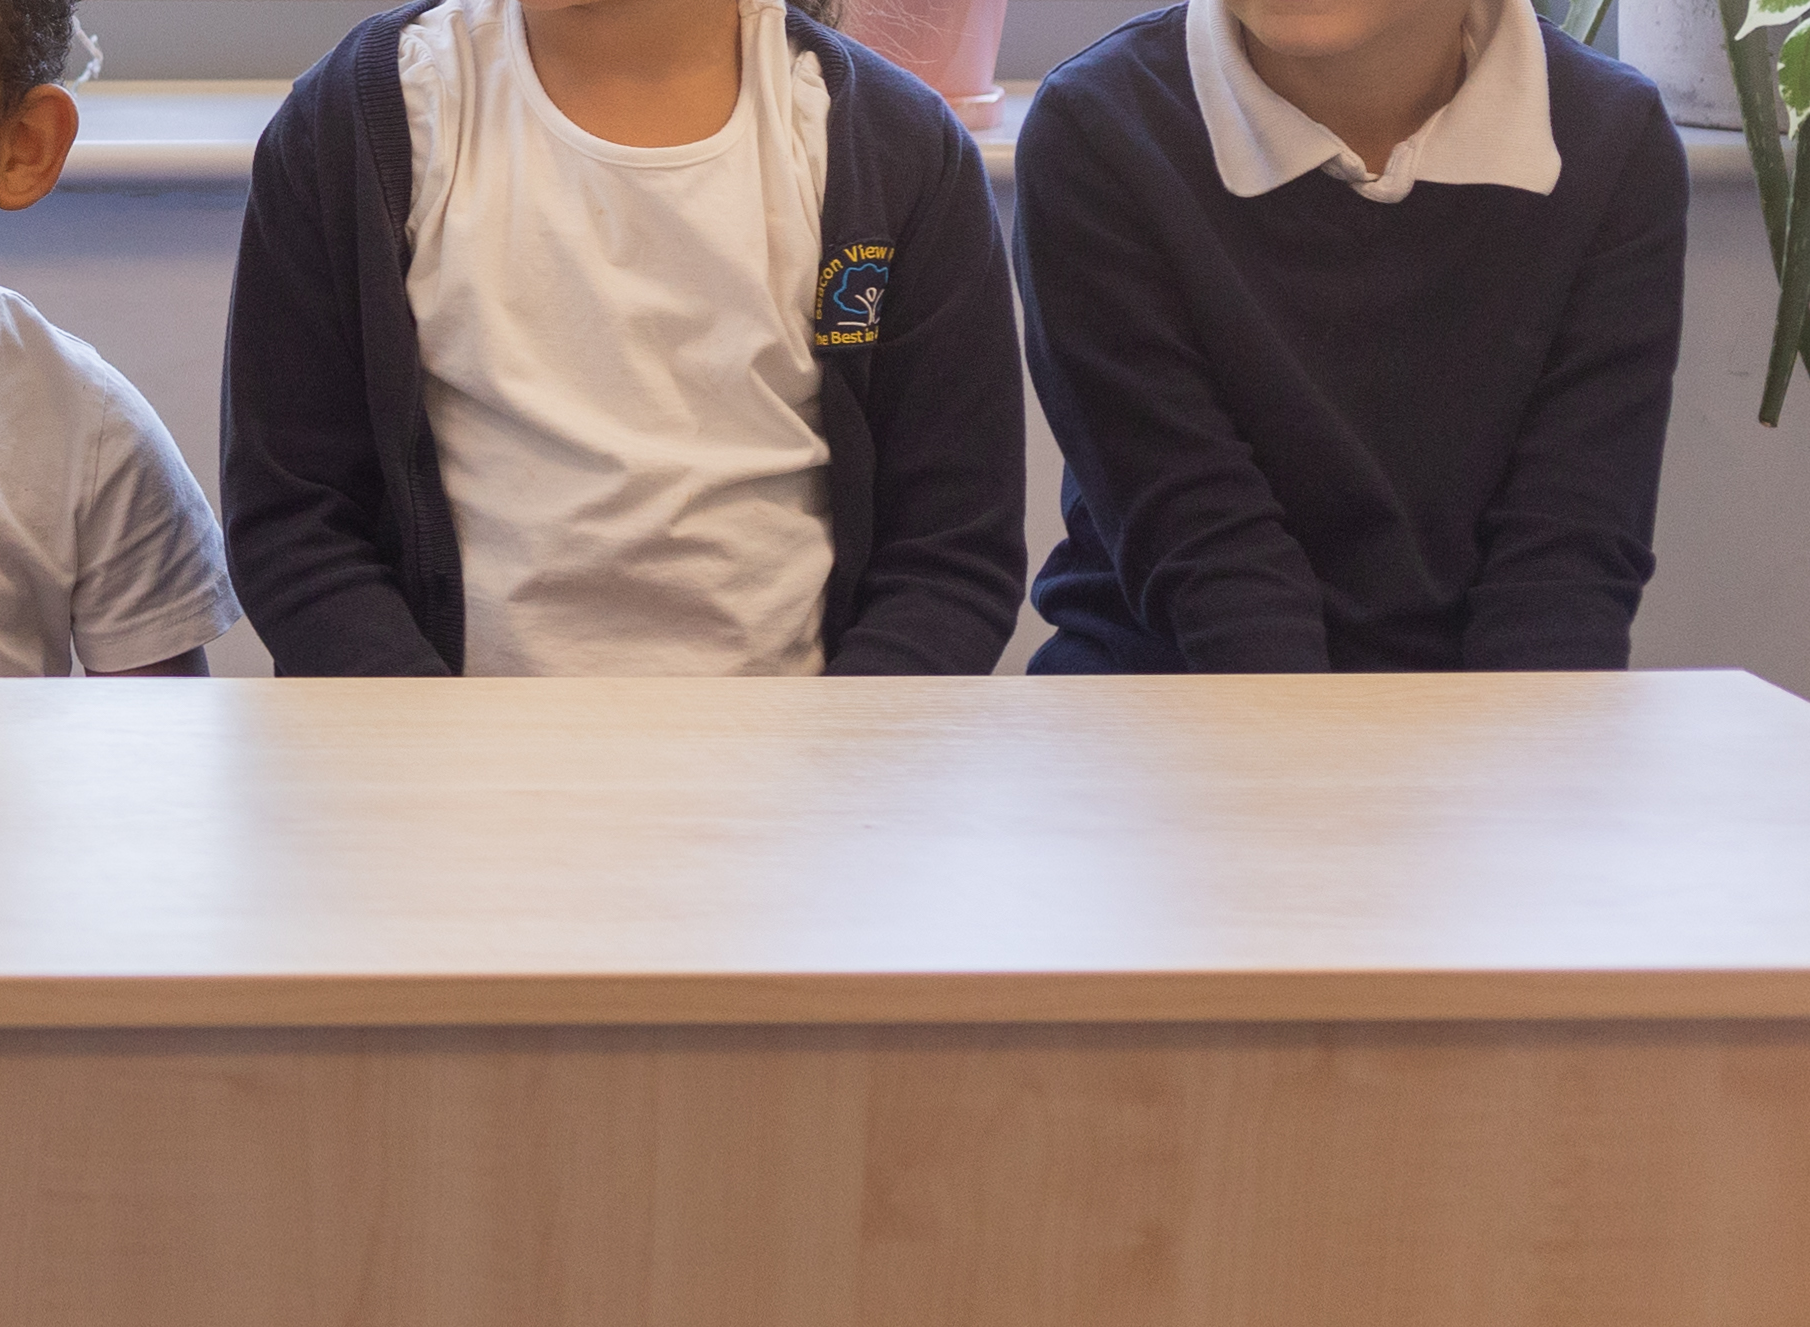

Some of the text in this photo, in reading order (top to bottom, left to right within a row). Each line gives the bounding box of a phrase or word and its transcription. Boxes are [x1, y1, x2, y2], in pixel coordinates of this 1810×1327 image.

[843, 244, 887, 263] View
[831, 331, 864, 345] Best
[865, 327, 874, 342] in
